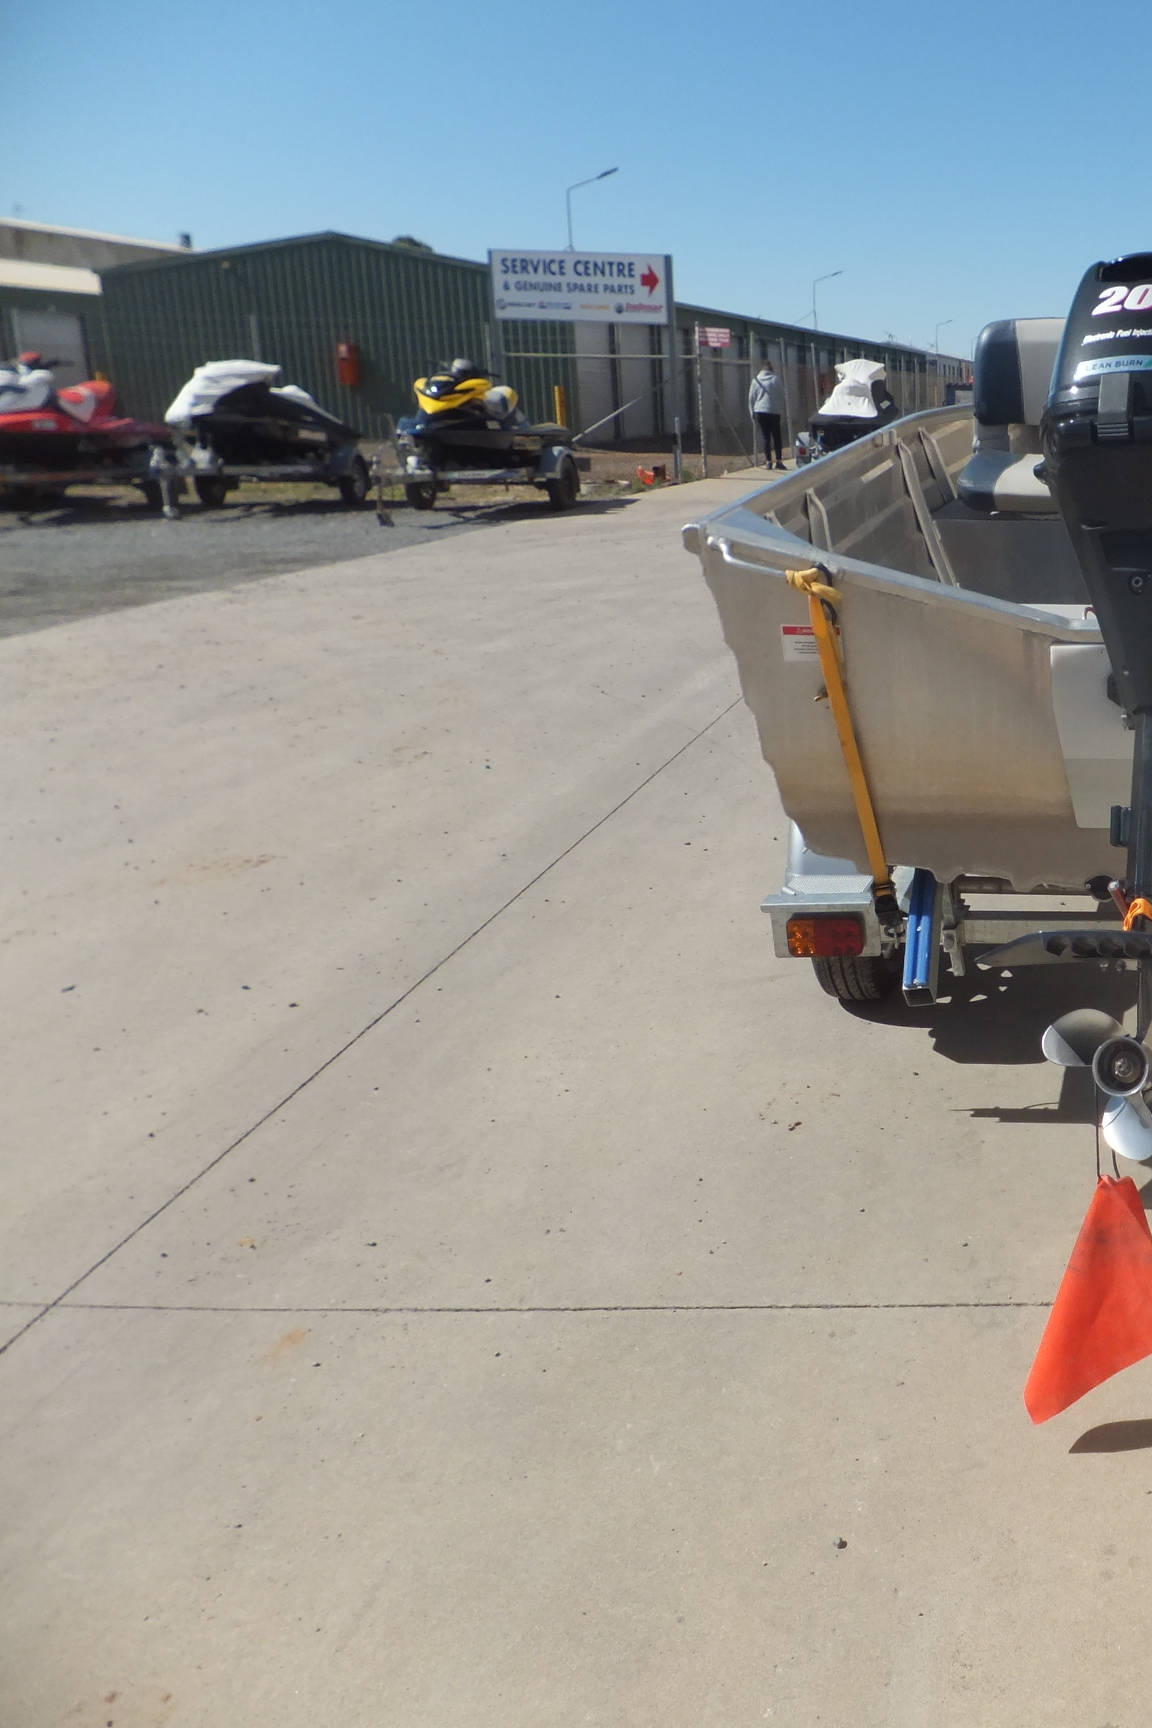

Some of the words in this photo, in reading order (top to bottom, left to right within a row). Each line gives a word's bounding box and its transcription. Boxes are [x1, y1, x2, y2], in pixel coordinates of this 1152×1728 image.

[501, 257, 566, 276] SERVICE
[573, 260, 636, 278] CENTRE
[503, 281, 510, 291] &
[514, 281, 564, 293] GENUINE
[567, 282, 599, 294] SPARE
[603, 283, 635, 295] PARTS
[1116, 329, 1132, 338] Fuel
[1085, 362, 1112, 372] LEAN
[1114, 359, 1144, 368] BURN
